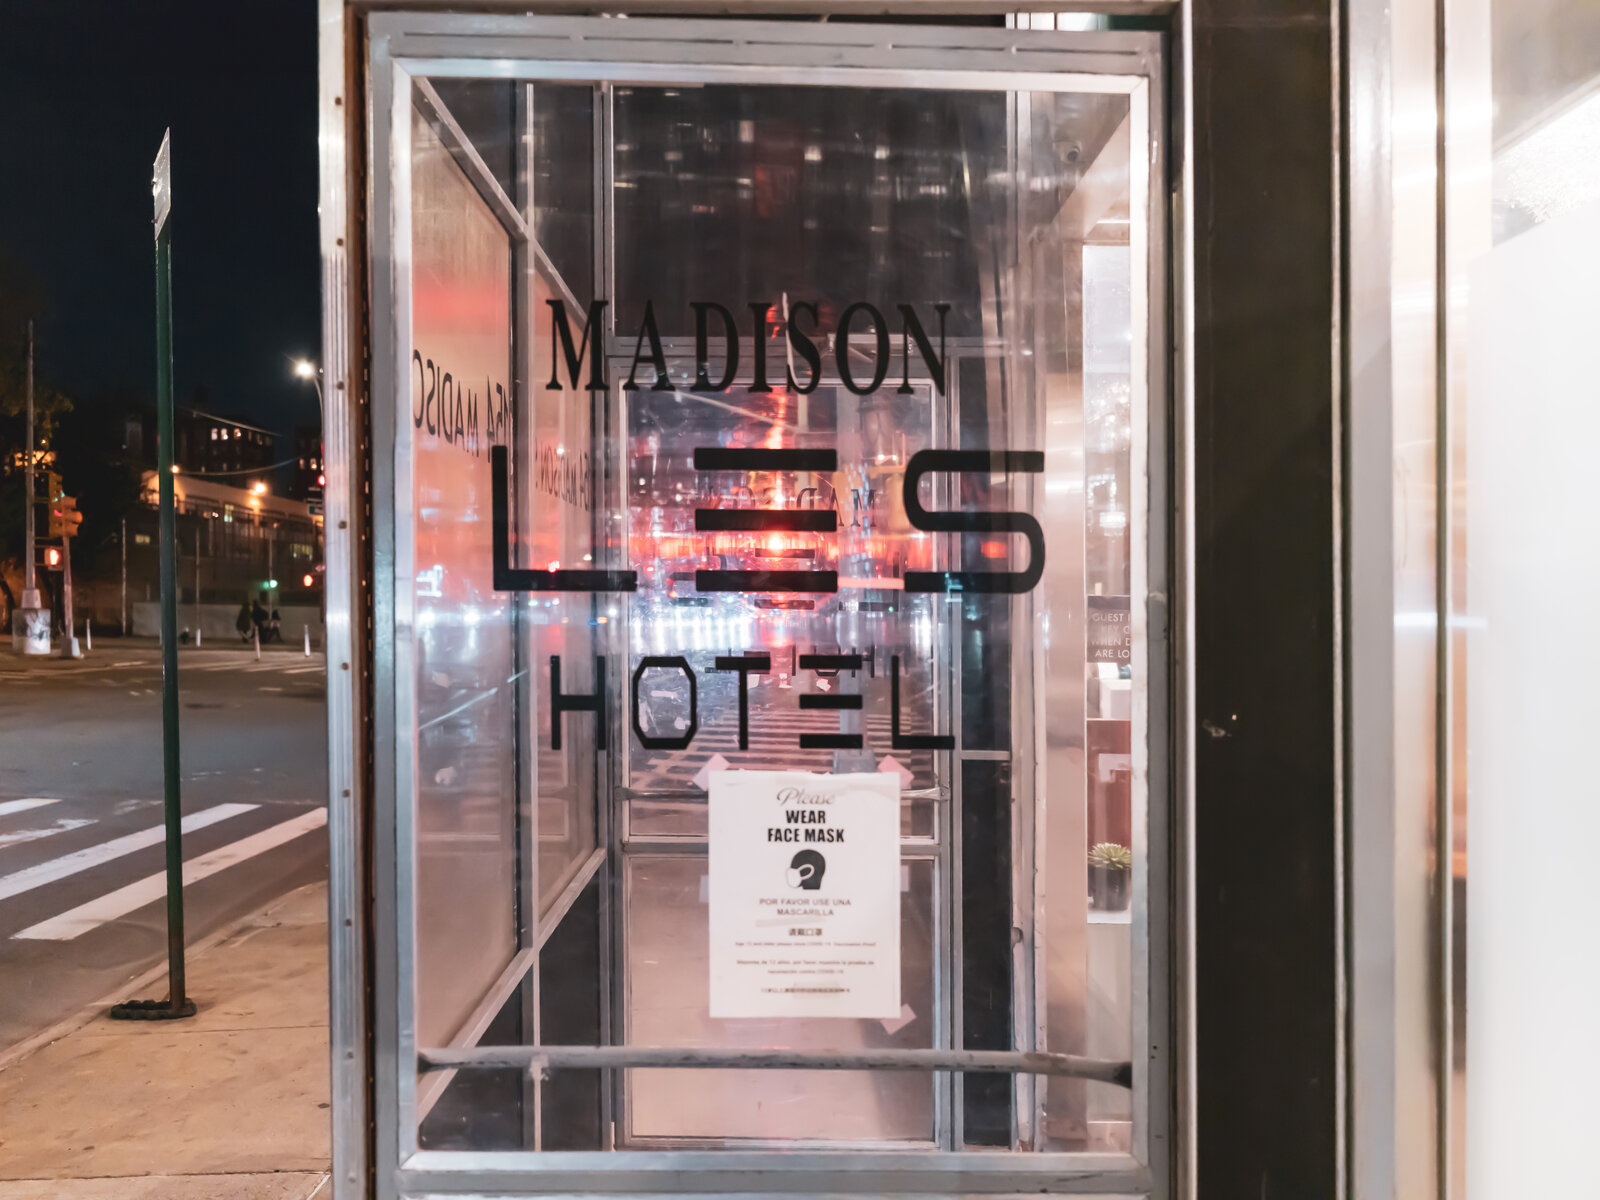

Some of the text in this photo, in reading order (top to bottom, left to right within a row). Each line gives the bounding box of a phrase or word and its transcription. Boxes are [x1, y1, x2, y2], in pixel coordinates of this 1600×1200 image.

[545, 299, 952, 396] MADISON
[491, 445, 1046, 593] LES
[1092, 613, 1124, 622] GUEST
[1095, 649, 1115, 658] ARE
[550, 655, 955, 750] HOTEL
[776, 787, 836, 806] Please
[785, 810, 826, 824] WEAR
[767, 828, 845, 843] FACE MASK
[759, 898, 852, 906] POR FAVOR USE UNA
[776, 908, 834, 916] MASCARILLA
